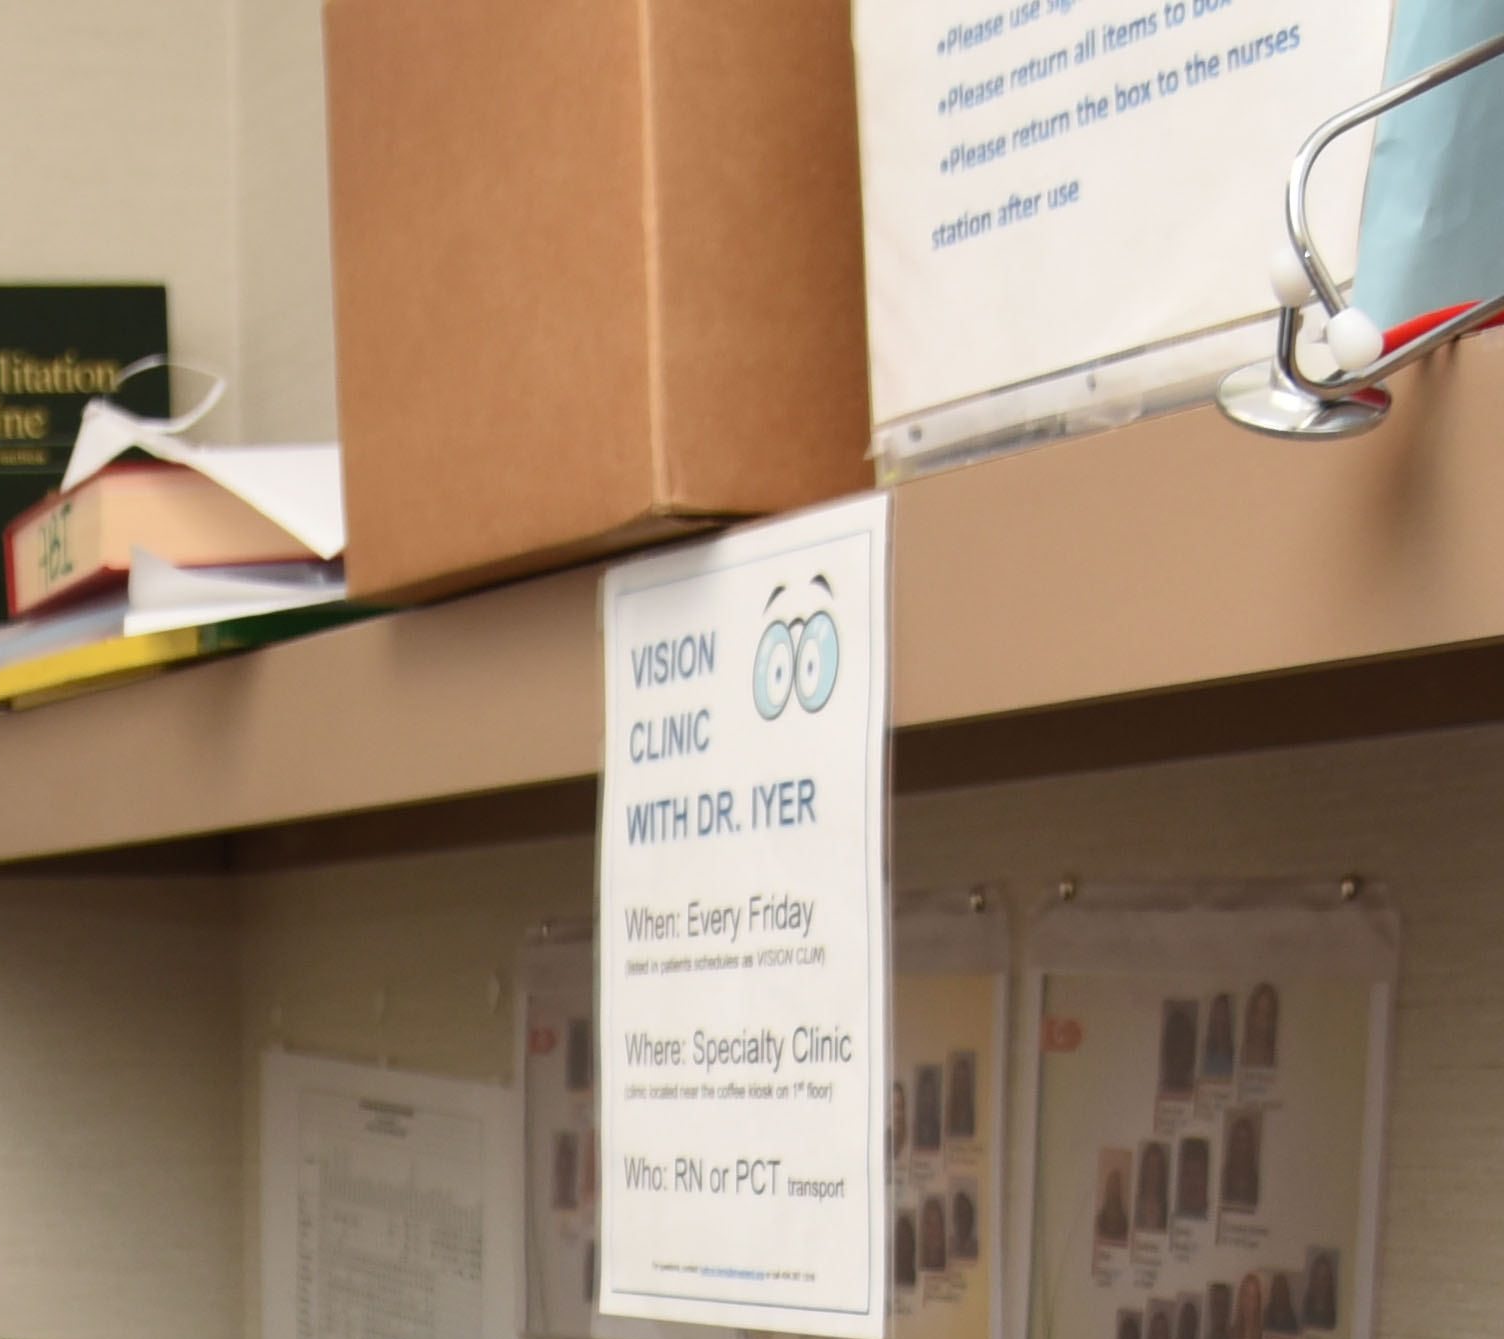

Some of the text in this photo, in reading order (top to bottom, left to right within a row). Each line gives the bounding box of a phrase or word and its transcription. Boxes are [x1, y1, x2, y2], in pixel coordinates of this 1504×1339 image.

[946, 0, 1041, 55] Please use
[946, 1, 1186, 115] Please return all items to
[949, 21, 1302, 175] Please return the box to the nurses
[930, 176, 1081, 252] station after use
[631, 630, 717, 691] VISION
[629, 709, 710, 765] CLINIC
[626, 778, 817, 847] WITH DR. IYER
[624, 894, 815, 943] When: Every Friday
[757, 948, 792, 967] VISION
[624, 1025, 853, 1073] Where: Specialty Clinic
[624, 1157, 846, 1203] Who: RN or PCT transport
